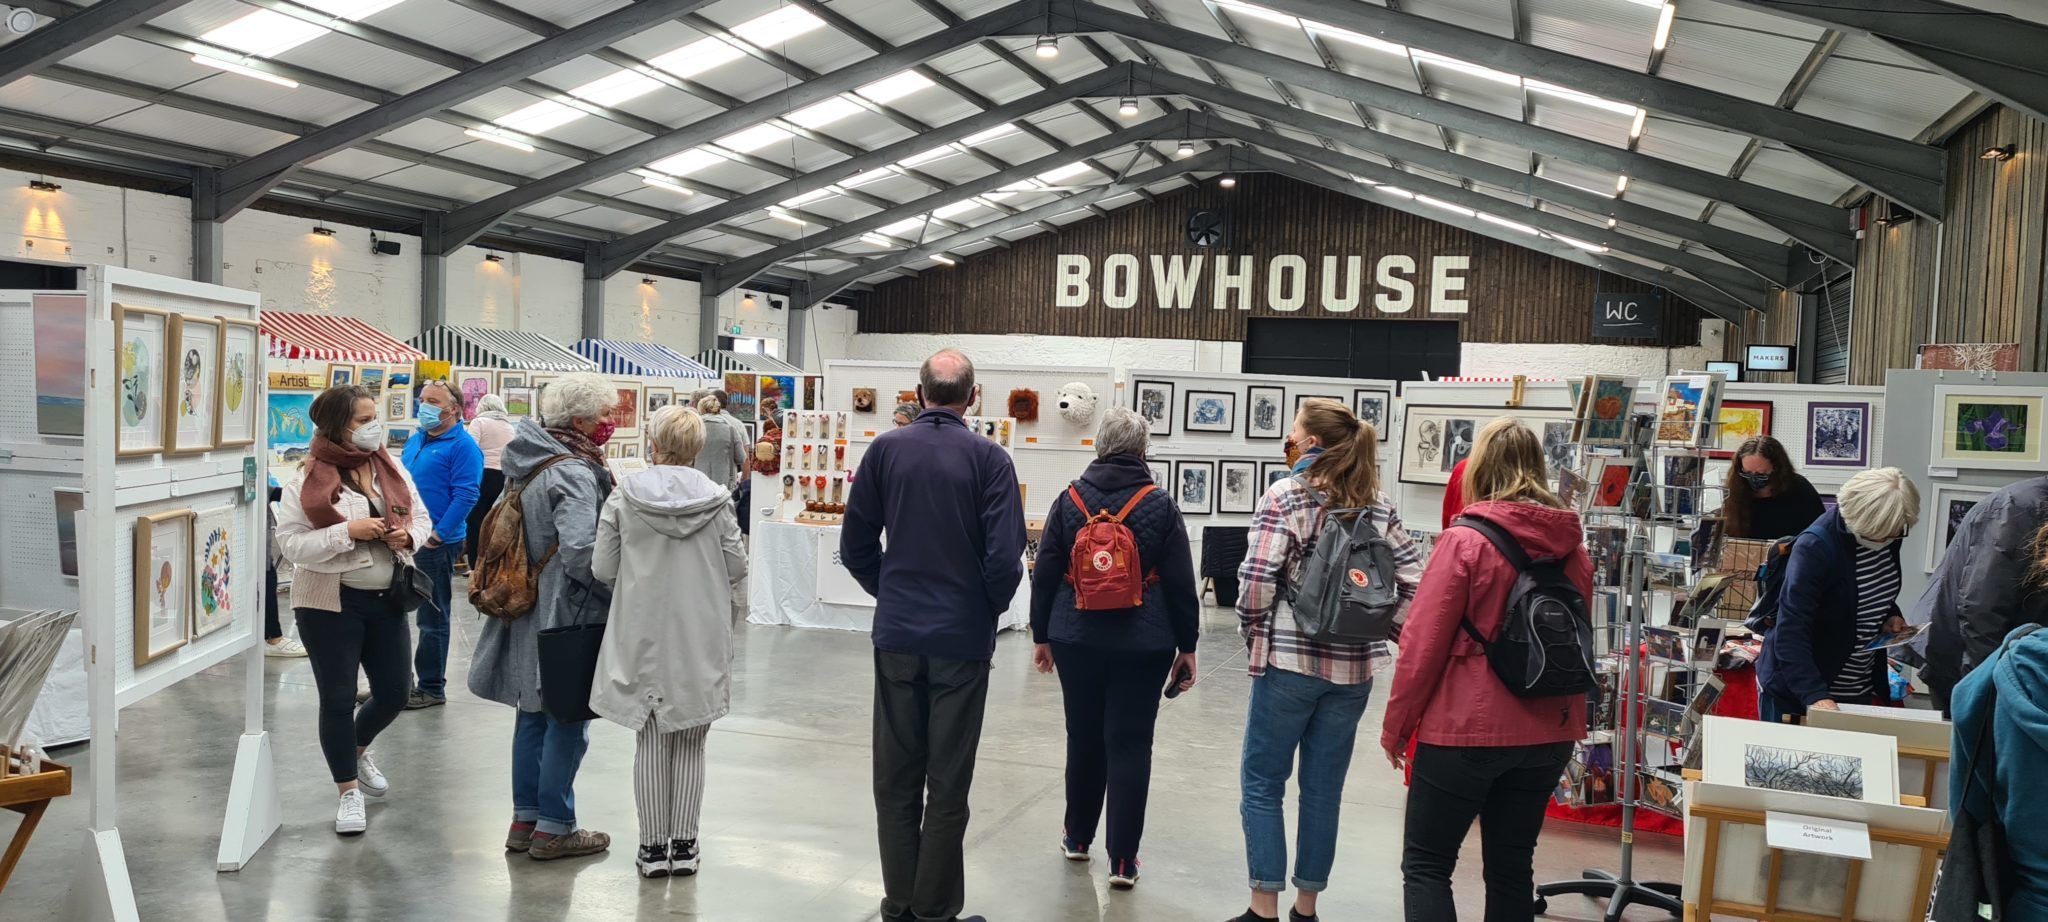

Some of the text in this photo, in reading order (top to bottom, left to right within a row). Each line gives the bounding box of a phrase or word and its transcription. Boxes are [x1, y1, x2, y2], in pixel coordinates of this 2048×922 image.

[1055, 253, 1470, 314] BOWHOUSE
[1752, 354, 1785, 362] MAKERS
[280, 374, 309, 387] Artist
[1802, 824, 1832, 834] Original
[1802, 832, 1834, 841] Artwork
